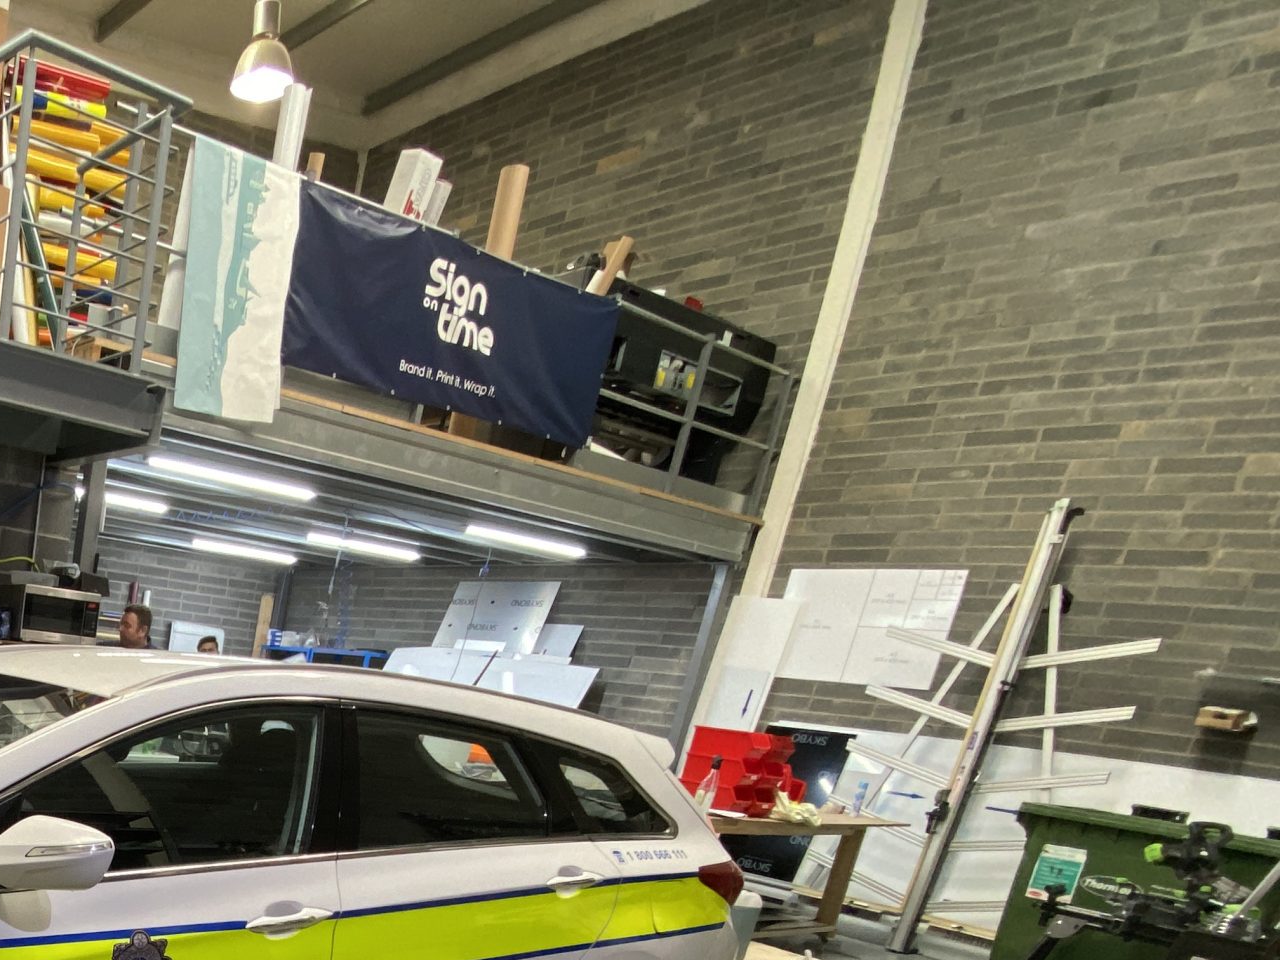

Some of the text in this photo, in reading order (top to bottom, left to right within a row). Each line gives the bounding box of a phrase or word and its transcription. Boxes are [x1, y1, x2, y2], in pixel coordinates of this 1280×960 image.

[423, 297, 438, 312] on
[425, 257, 488, 317] Sign
[437, 303, 494, 357] time
[399, 359, 496, 398] Brand it. Print it. Wrap it.
[634, 850, 653, 860] 800
[672, 849, 688, 859] 111
